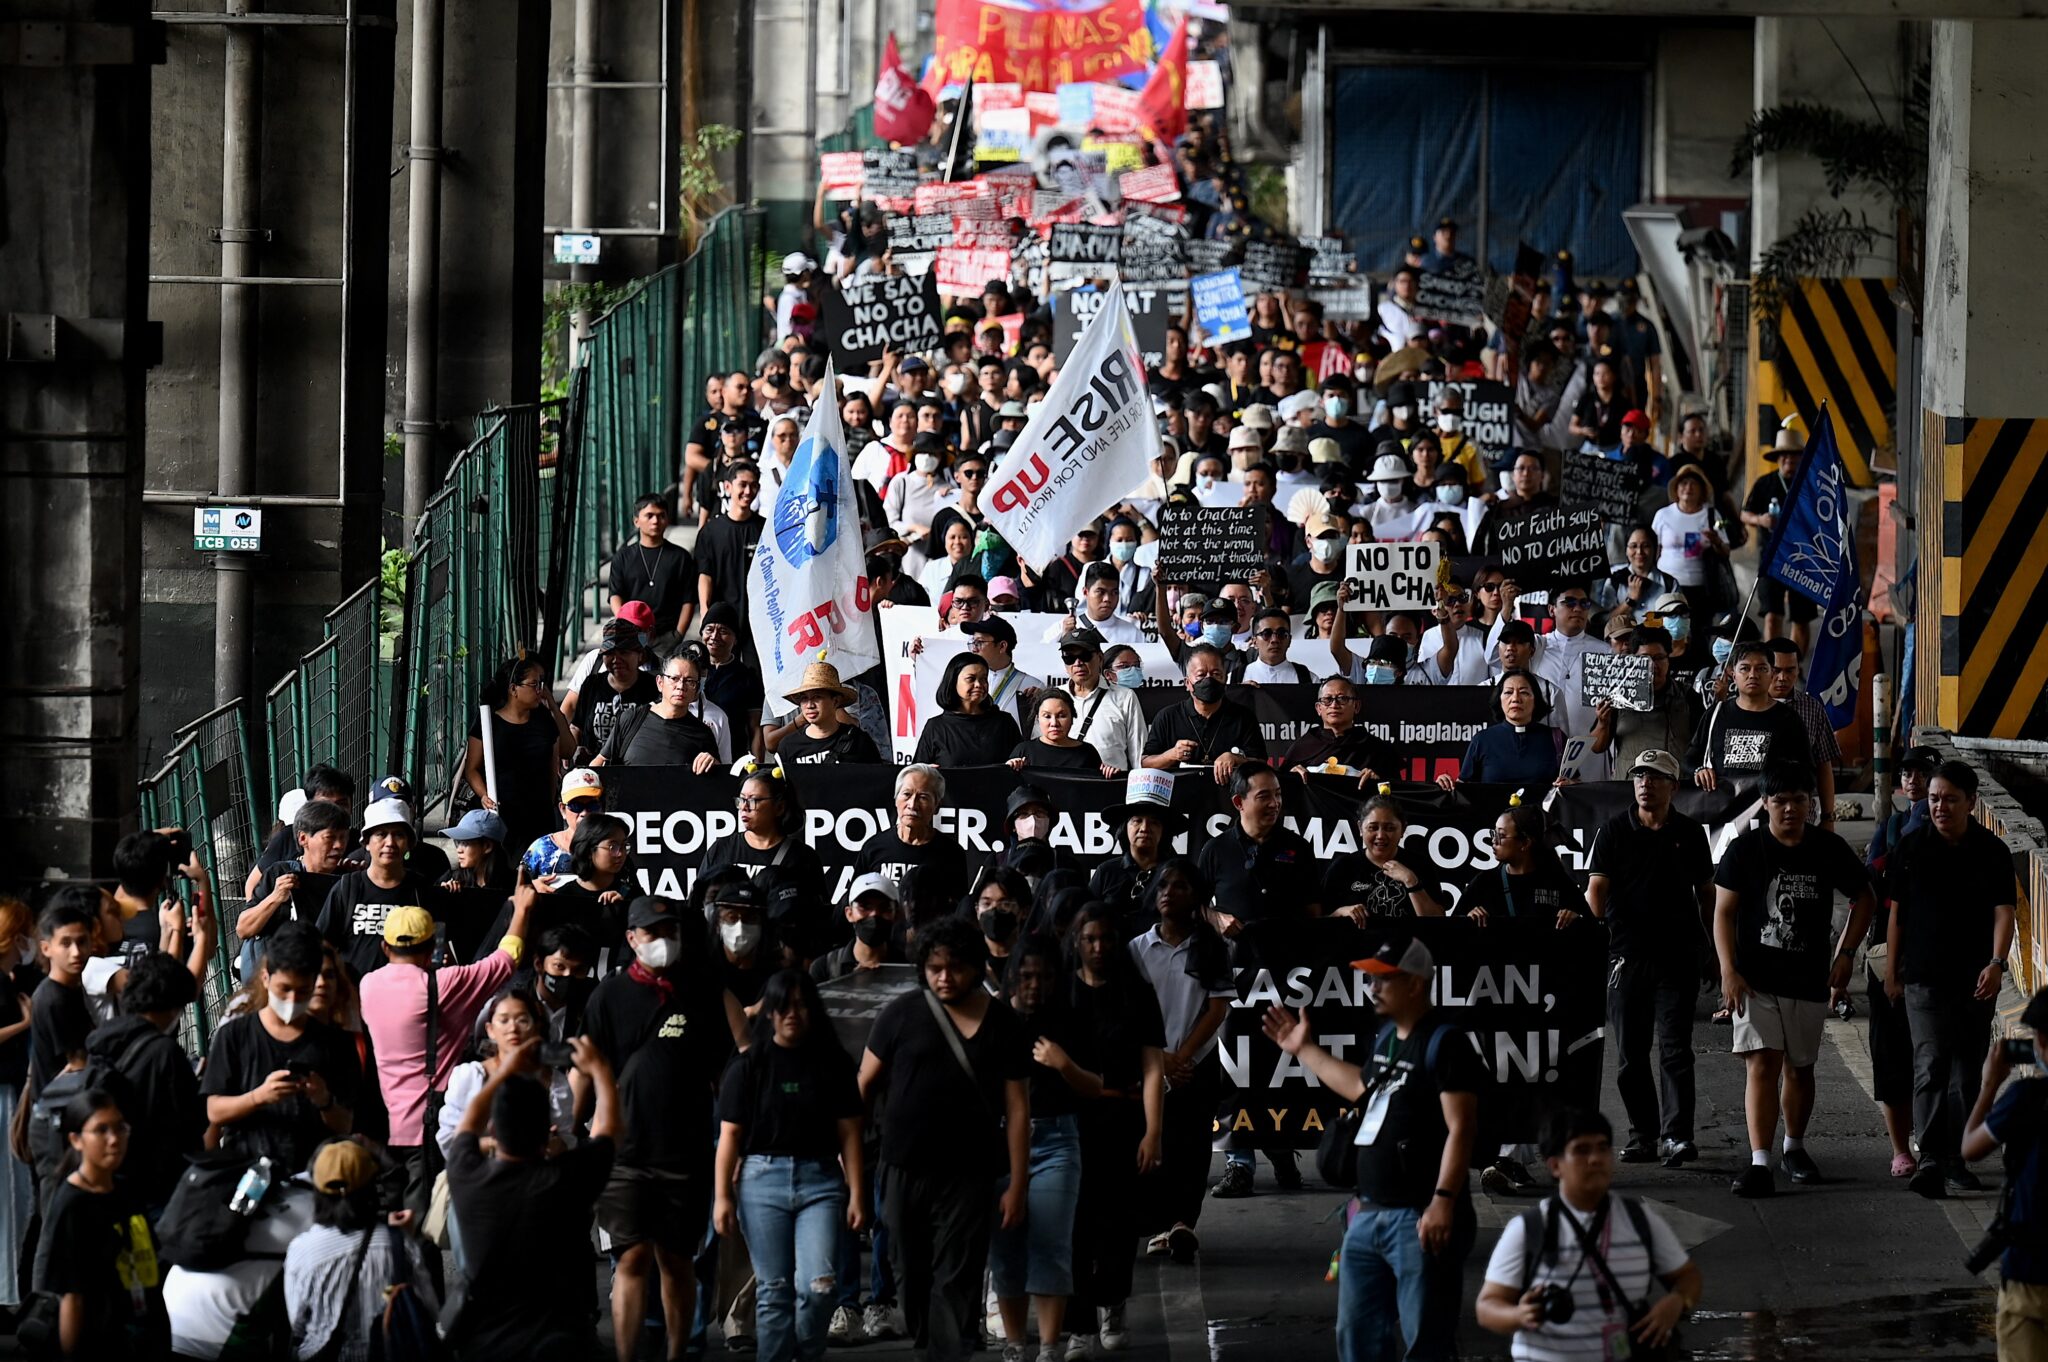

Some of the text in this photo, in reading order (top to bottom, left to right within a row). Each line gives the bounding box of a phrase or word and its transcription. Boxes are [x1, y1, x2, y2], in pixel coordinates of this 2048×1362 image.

[841, 275, 926, 306] WE SAY
[854, 295, 925, 326] NO TO
[841, 313, 939, 351] CHACHA
[1428, 381, 1477, 401] NT
[1162, 508, 1177, 522] No
[1179, 508, 1192, 521] to
[1498, 507, 1599, 541] Our Faith says
[1160, 521, 1257, 537] Not at this time.
[196, 537, 257, 549] TCB 055
[1160, 537, 1254, 554] Not for the wrong
[1502, 529, 1605, 566] NO TO CHACHA!
[1160, 550, 1264, 567] reasons, not through
[1356, 546, 1431, 572] NO TO
[1780, 561, 1823, 598] National
[1346, 572, 1437, 608] CHA CHA
[593, 713, 617, 727] AGA
[1280, 721, 1296, 740] at
[1730, 735, 1766, 746] DEFEND
[1730, 744, 1761, 755] PRESS
[1723, 753, 1767, 765] FREEDOM
[1282, 815, 1502, 871] MACOS
[1780, 884, 1815, 892] ERICSON
[1783, 874, 1817, 883] JUSTICE
[1229, 964, 1556, 1013] ASARLAN,
[1212, 1107, 1360, 1132] AYAN
